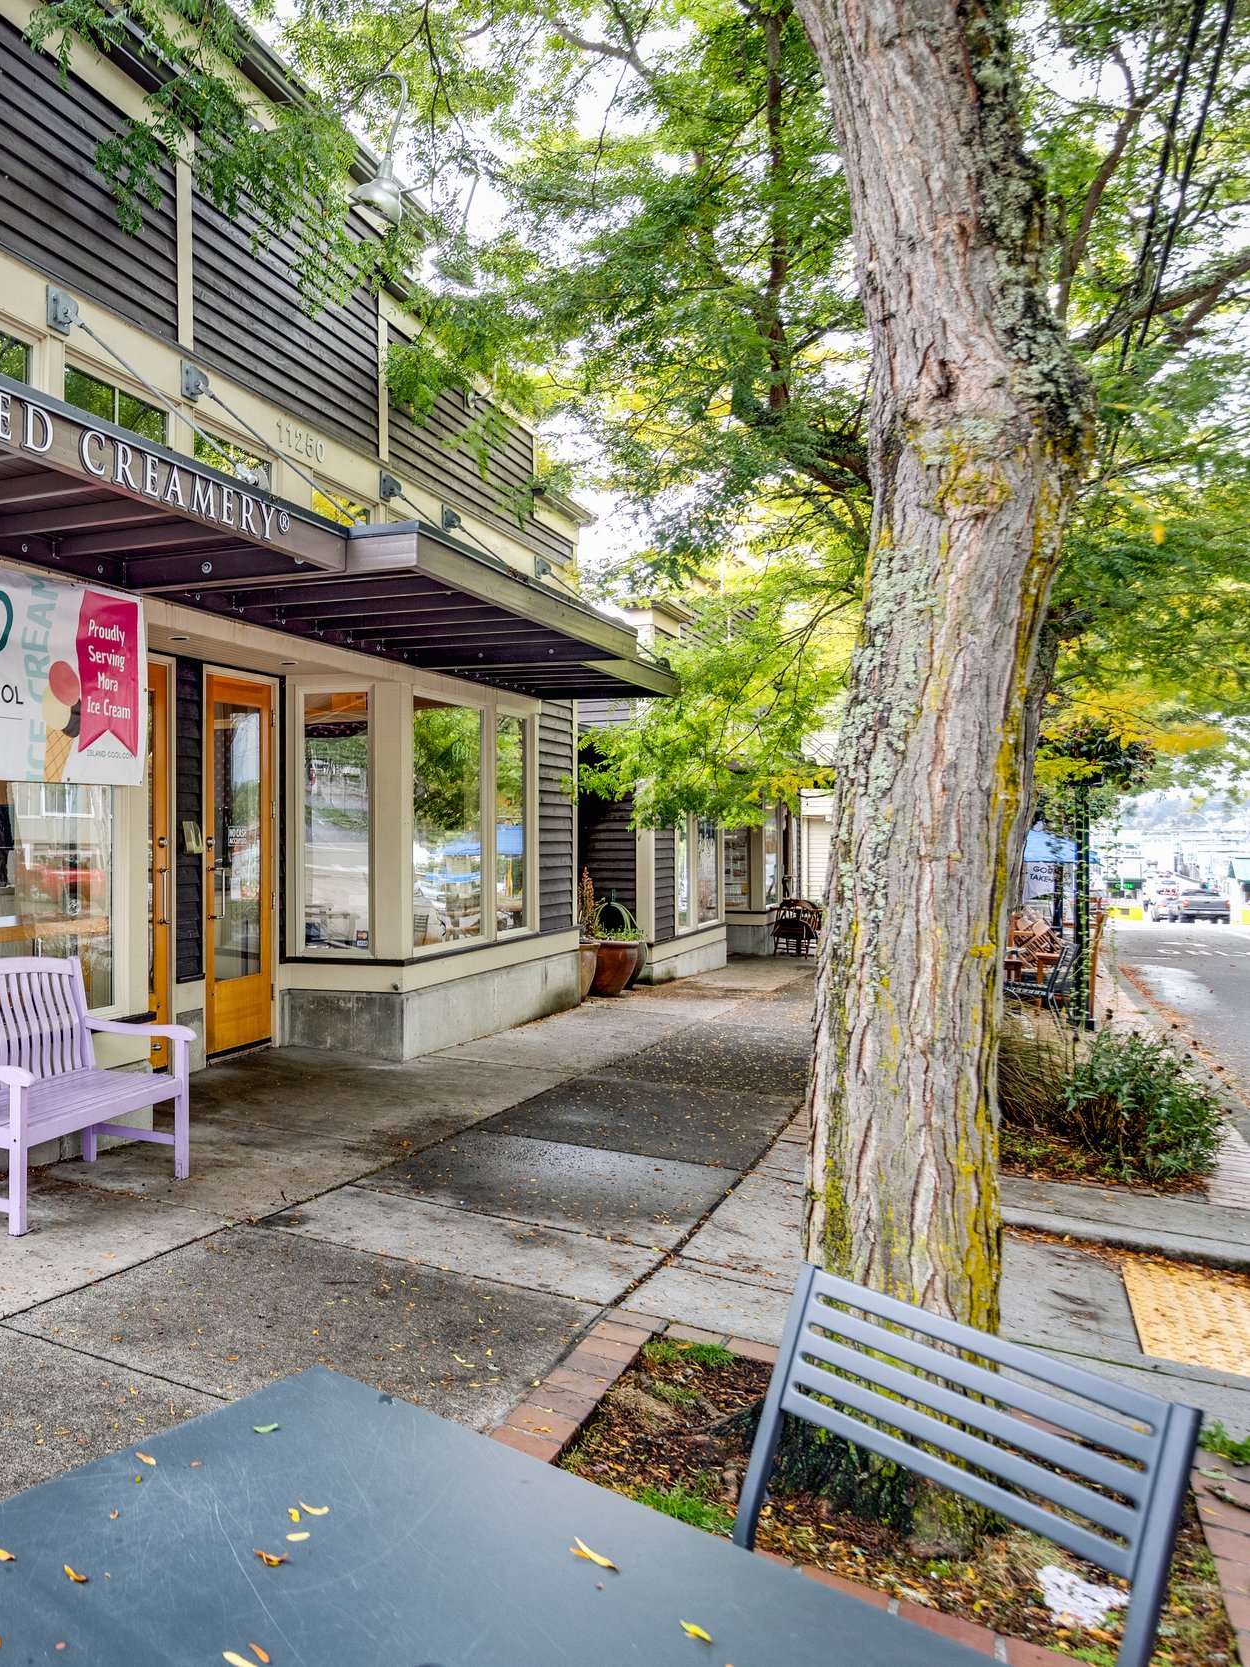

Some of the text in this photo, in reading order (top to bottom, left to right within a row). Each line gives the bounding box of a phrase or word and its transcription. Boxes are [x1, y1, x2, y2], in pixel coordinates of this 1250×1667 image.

[276, 418, 325, 463] 11250
[21, 574, 59, 704] CREAM
[88, 618, 126, 647] Proudly
[88, 645, 126, 673] Serving
[97, 671, 118, 692] Mora
[87, 695, 131, 720] Ice Cream
